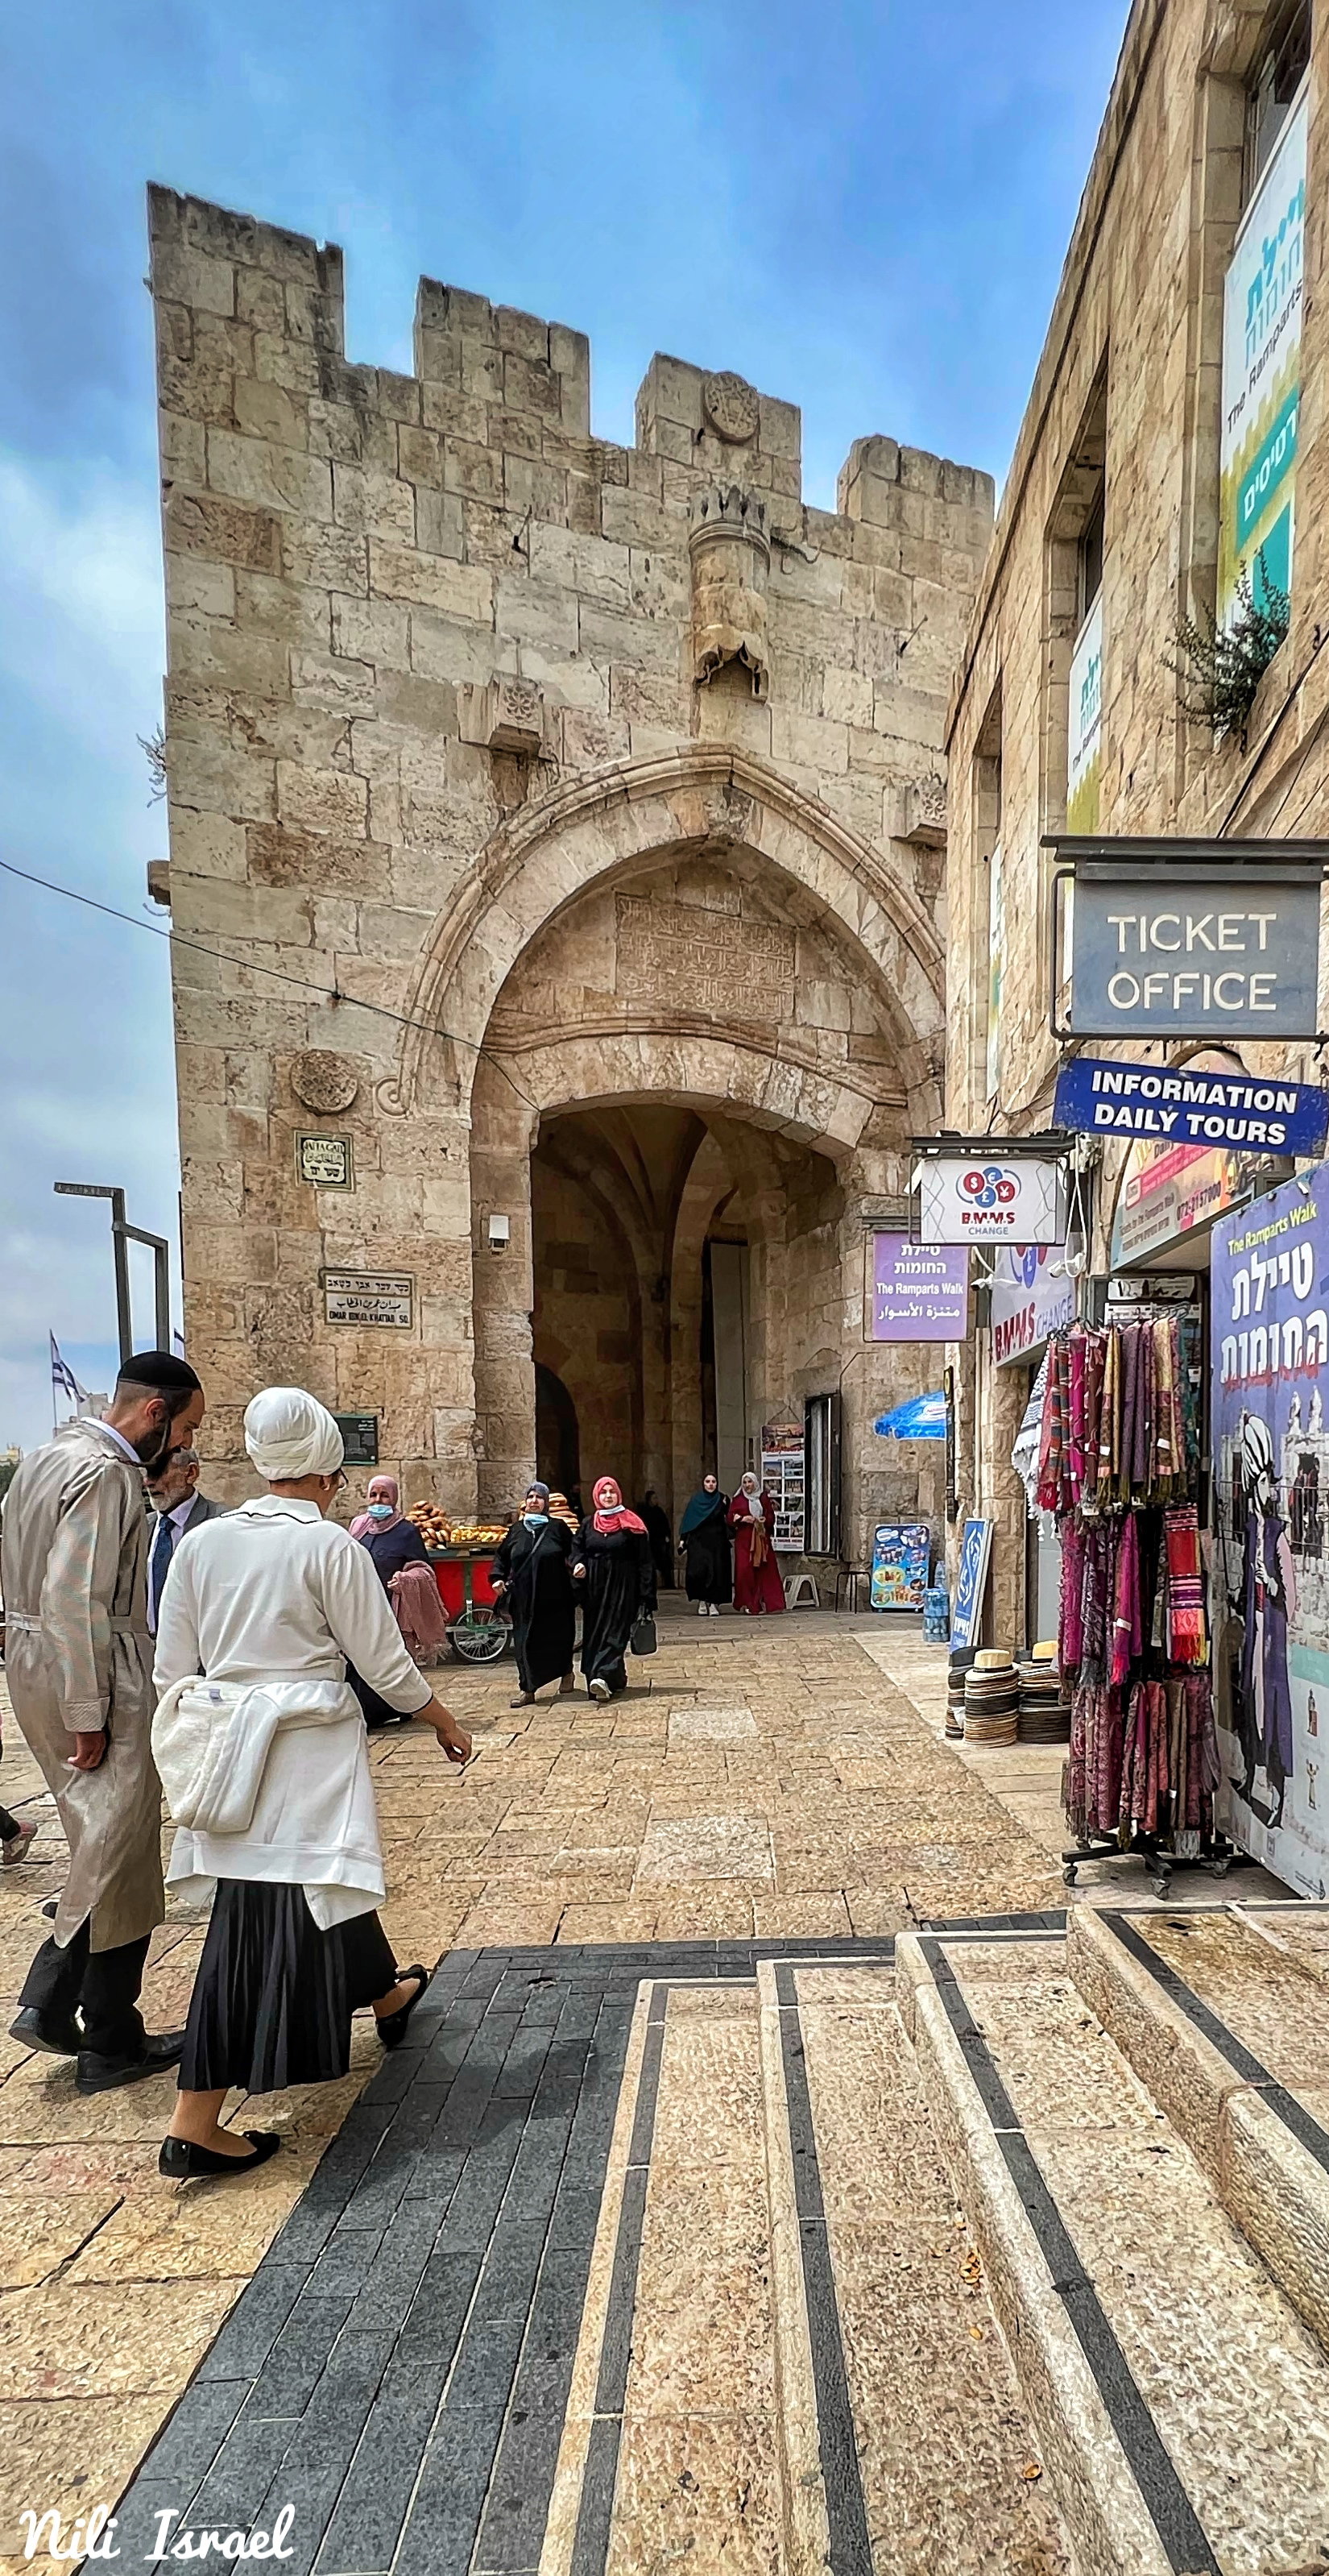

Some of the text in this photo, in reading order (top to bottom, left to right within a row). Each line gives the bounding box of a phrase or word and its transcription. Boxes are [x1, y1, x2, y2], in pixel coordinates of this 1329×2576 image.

[1245, 230, 1301, 370] חומות
[1228, 278, 1302, 433] The Ramparts
[1244, 403, 1298, 522] רטיסים
[1107, 914, 1277, 952] TICKET
[1108, 972, 1277, 1010] OFFICE
[1091, 1071, 1297, 1114] INFORMATION
[1094, 1103, 1286, 1145] DAILY TOURS
[968, 1227, 1008, 1235] CHANGE
[1228, 1201, 1317, 1256] The Ramparts Walk
[876, 1283, 963, 1297] The Ramparts Walk
[894, 1263, 946, 1274] החומות
[1232, 1242, 1313, 1321] טיילת
[878, 1302, 923, 1320] الأسوار
[1037, 1294, 1072, 1339] CHANGE
[1220, 1309, 1327, 1383] החומות
